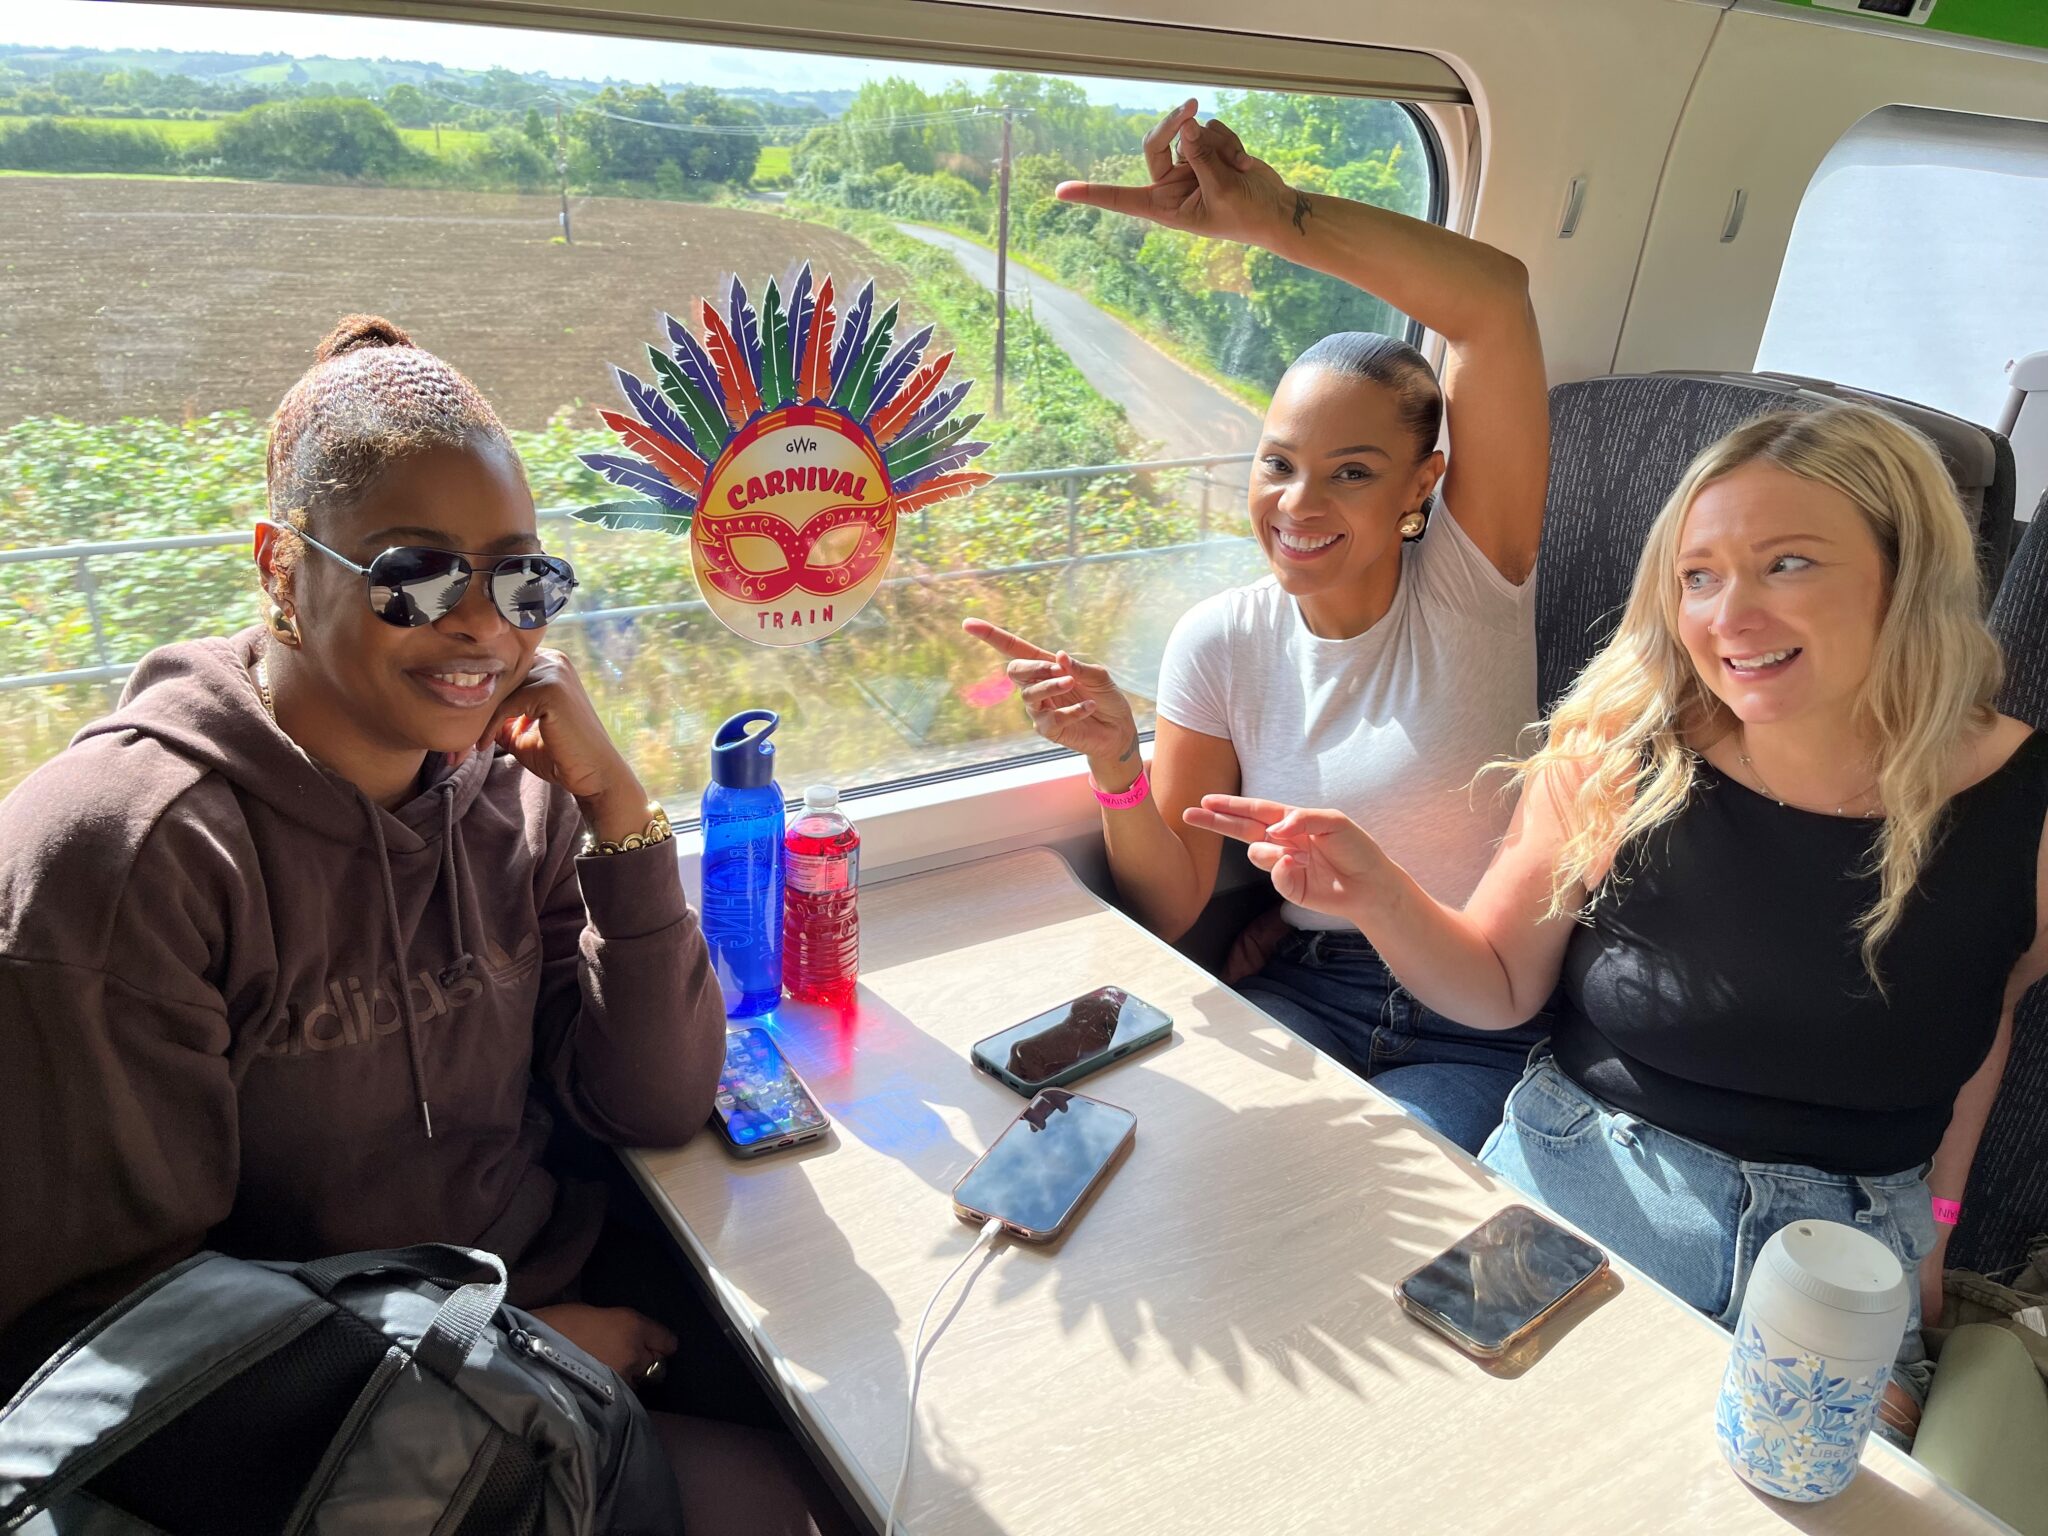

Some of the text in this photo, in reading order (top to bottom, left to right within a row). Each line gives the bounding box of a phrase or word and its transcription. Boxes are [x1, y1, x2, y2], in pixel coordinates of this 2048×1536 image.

[785, 436, 817, 454] GWR
[727, 466, 867, 510] CARNIVAL
[757, 604, 833, 629] TRAIN
